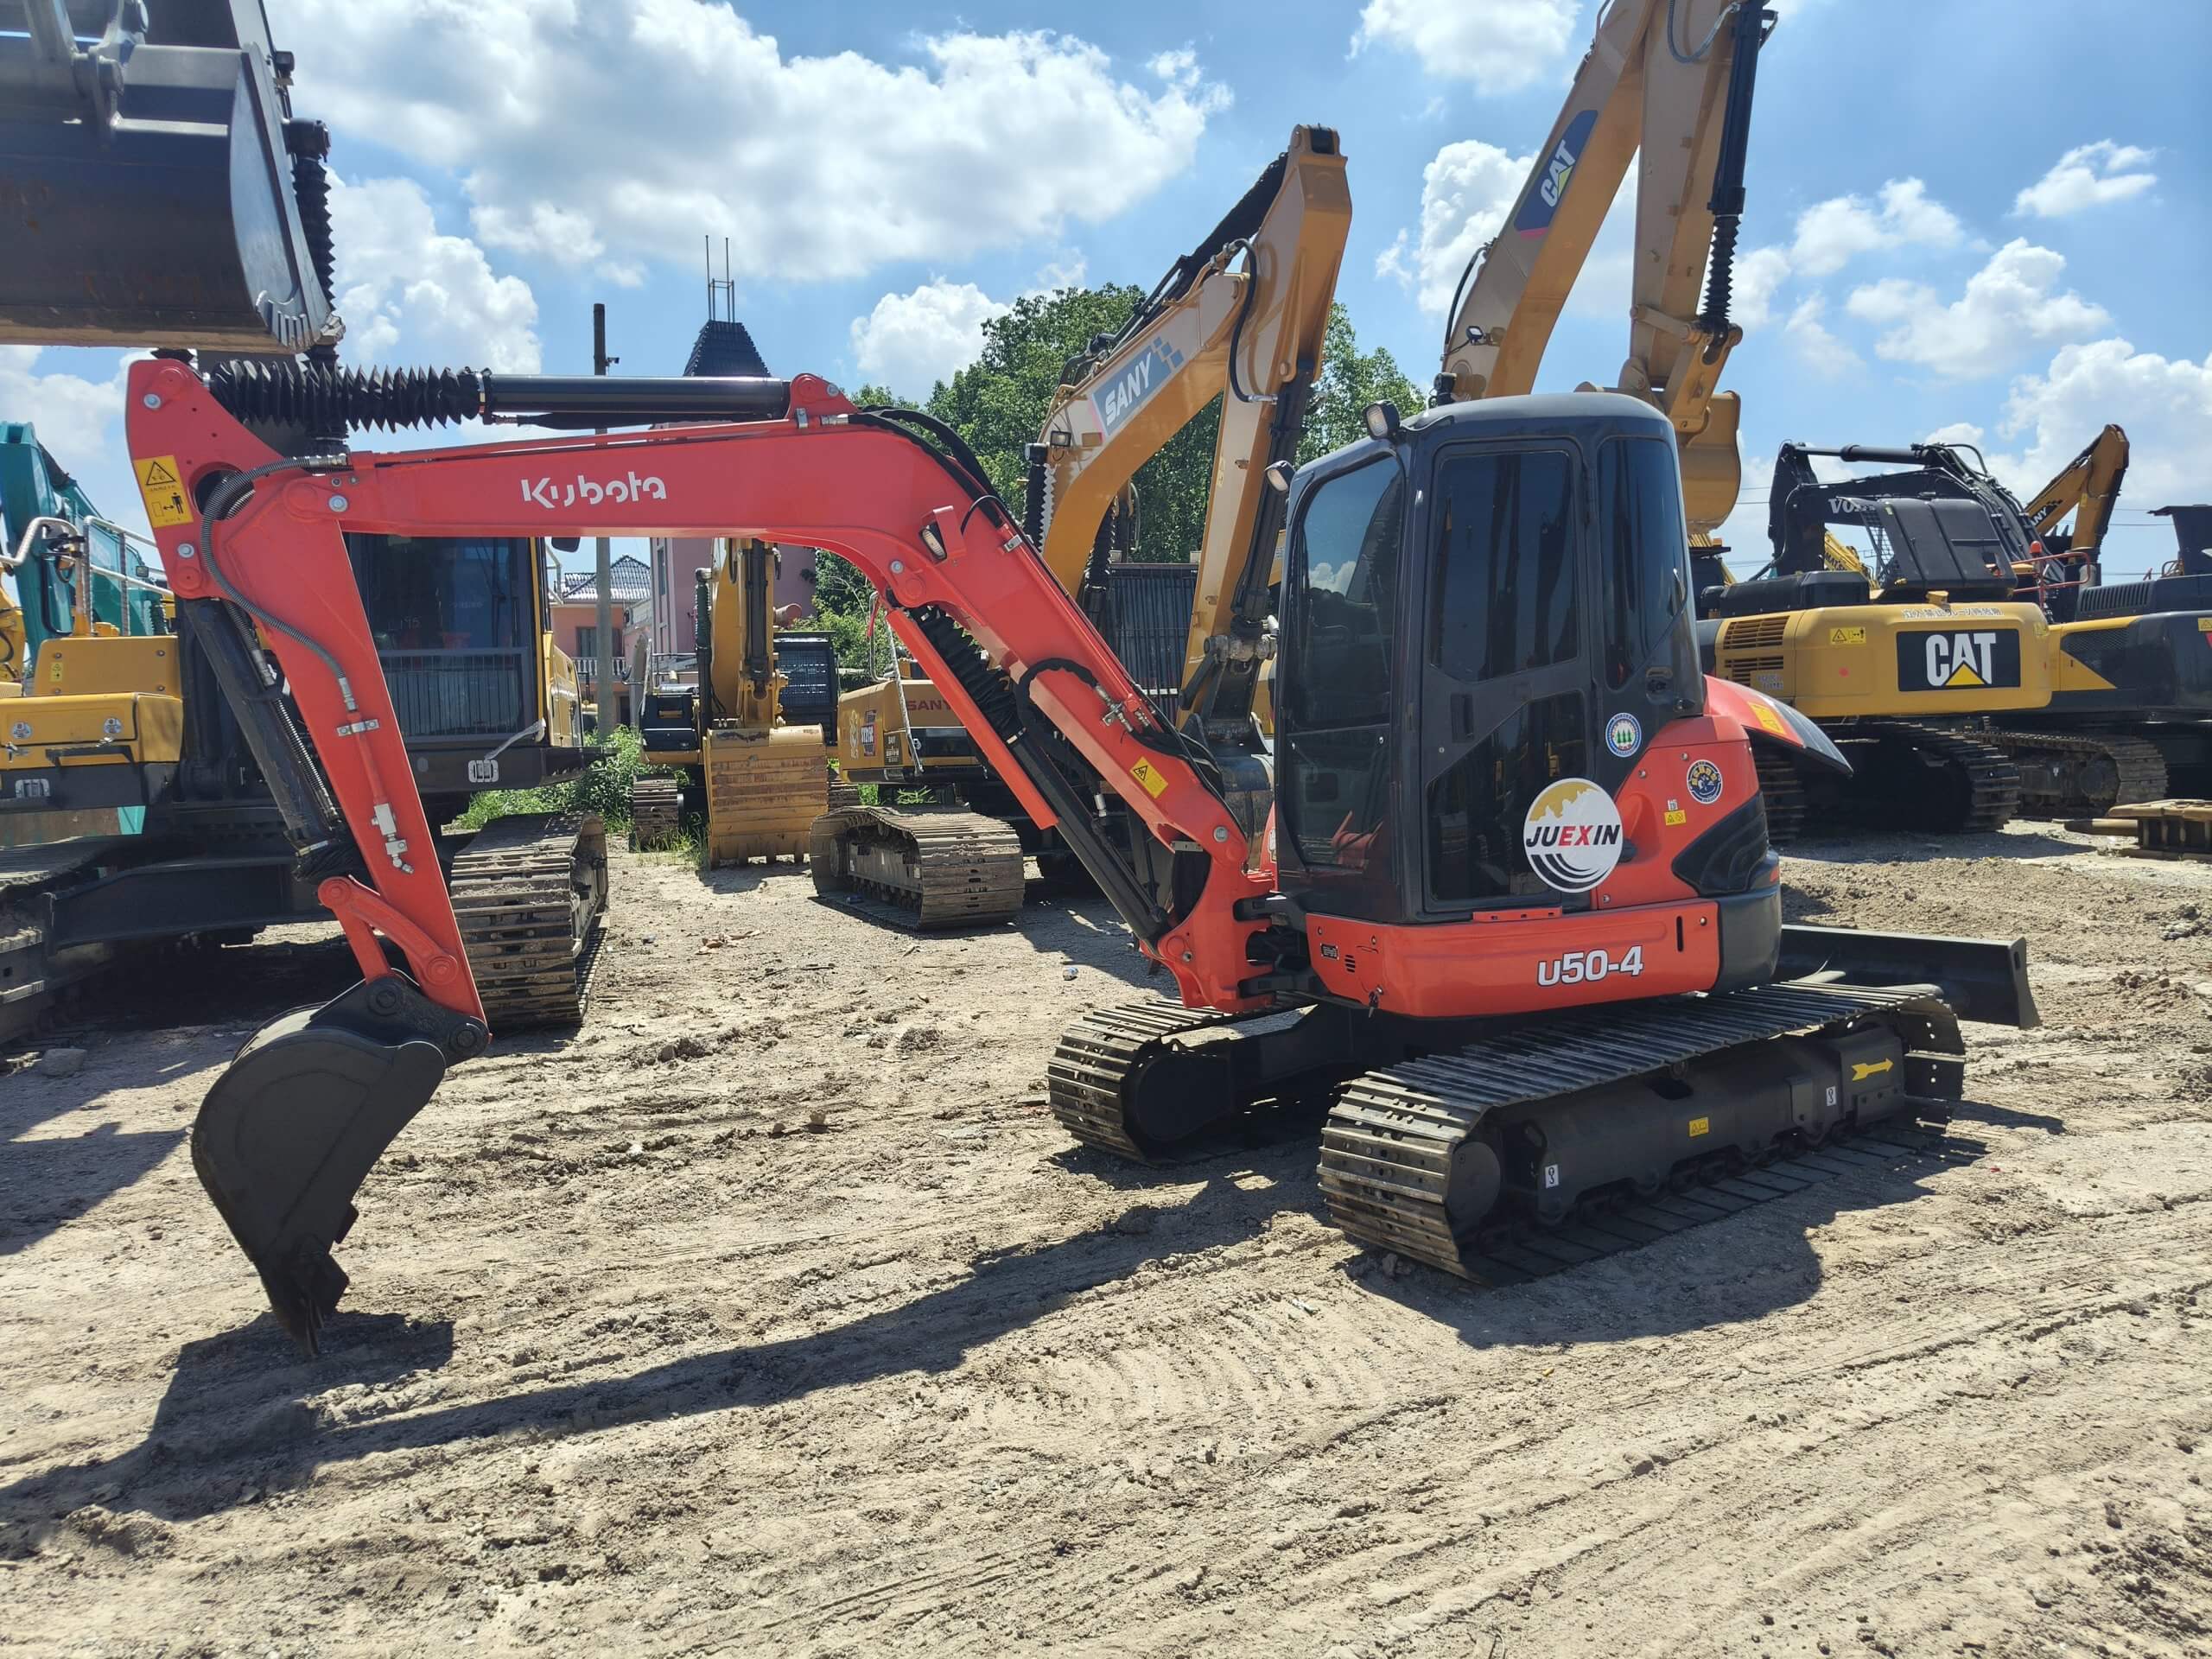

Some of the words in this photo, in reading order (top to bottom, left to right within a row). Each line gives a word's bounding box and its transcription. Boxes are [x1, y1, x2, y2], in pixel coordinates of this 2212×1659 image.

[1541, 139, 1576, 207] CAT
[1105, 352, 1152, 426] SANY
[520, 471, 667, 509] Kubota
[1925, 632, 1996, 686] CAT
[1525, 823, 1621, 848] JUEXIN
[1537, 944, 1643, 986] U50-4
